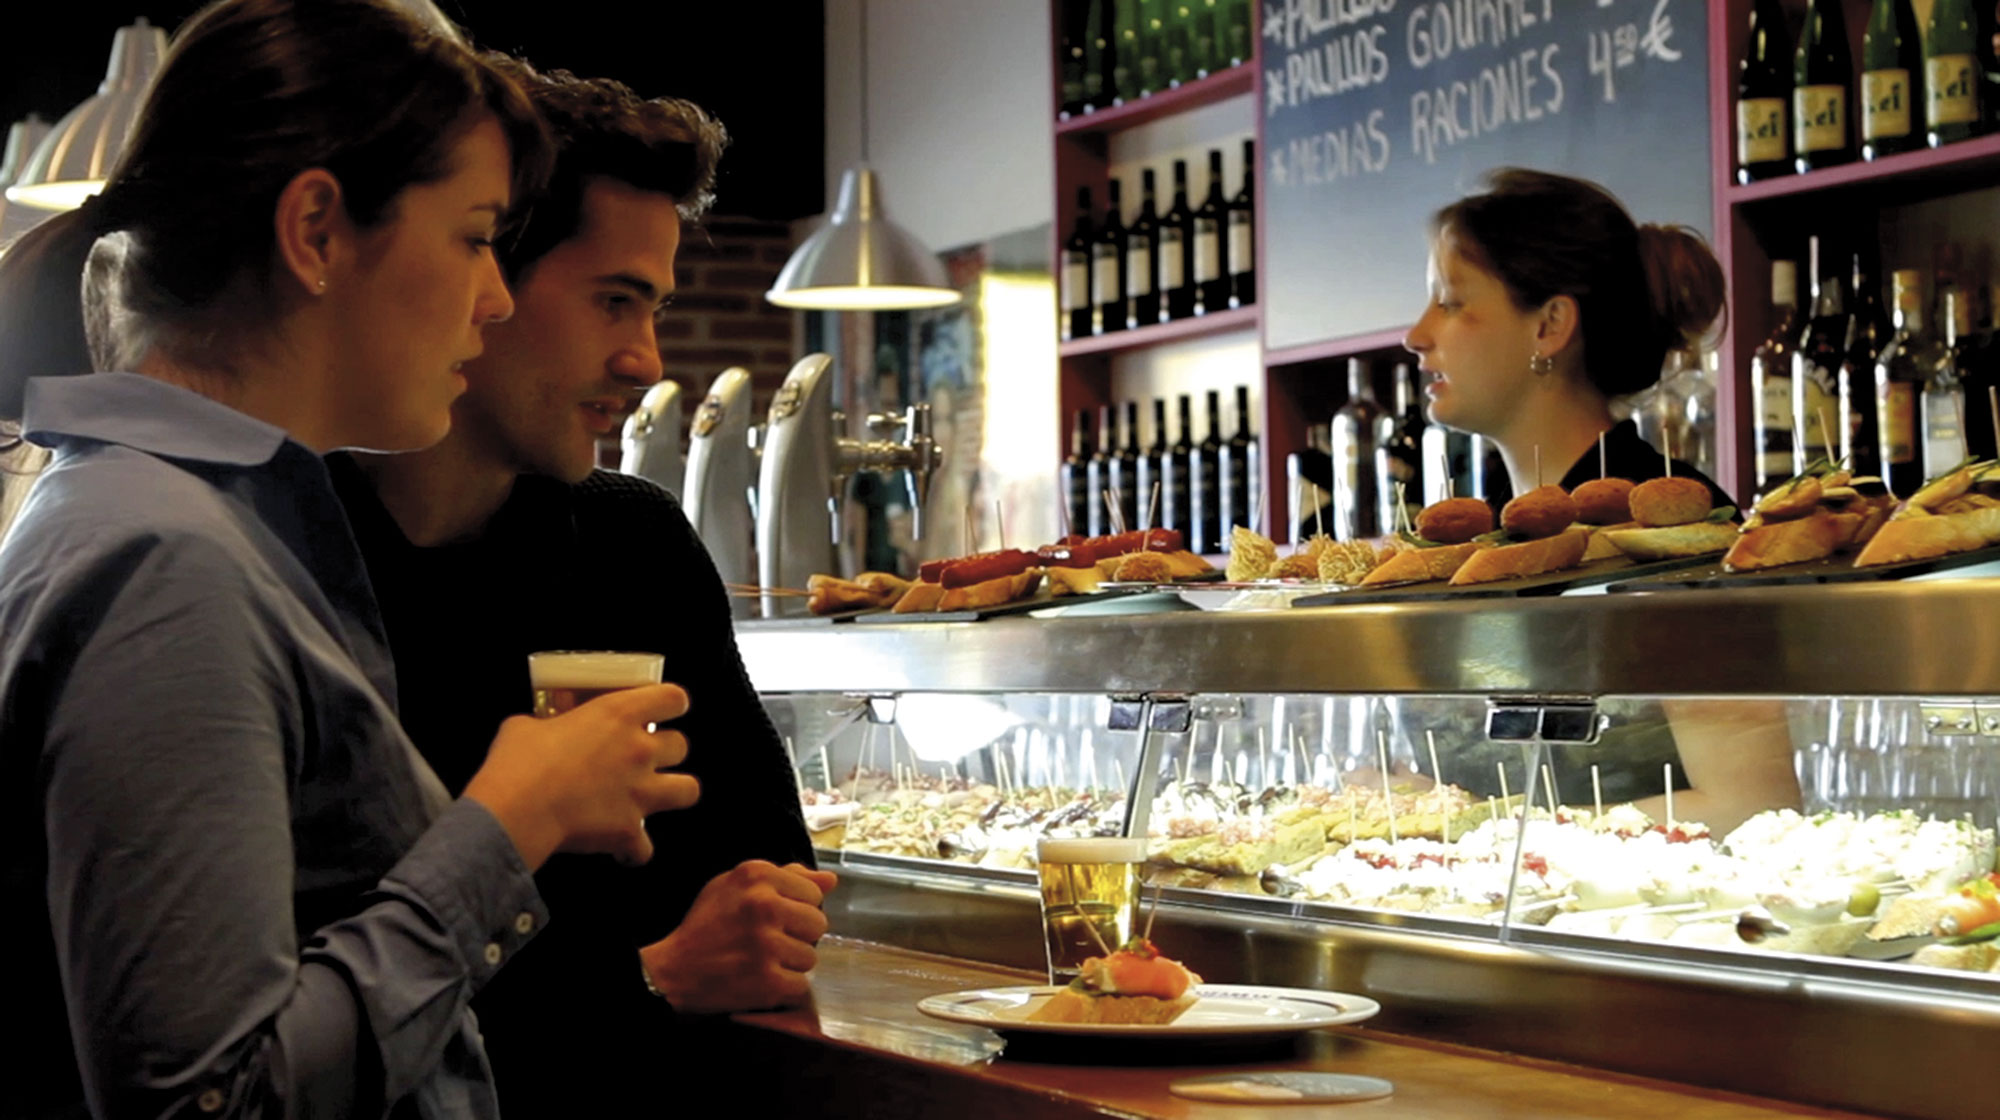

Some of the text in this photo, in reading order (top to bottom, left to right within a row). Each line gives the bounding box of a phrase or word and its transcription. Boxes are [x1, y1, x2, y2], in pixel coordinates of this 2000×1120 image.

[1285, 0, 1396, 50] PALIL
[1289, 109, 1390, 187] MEDIAS
[1411, 43, 1564, 164] RACIONES
